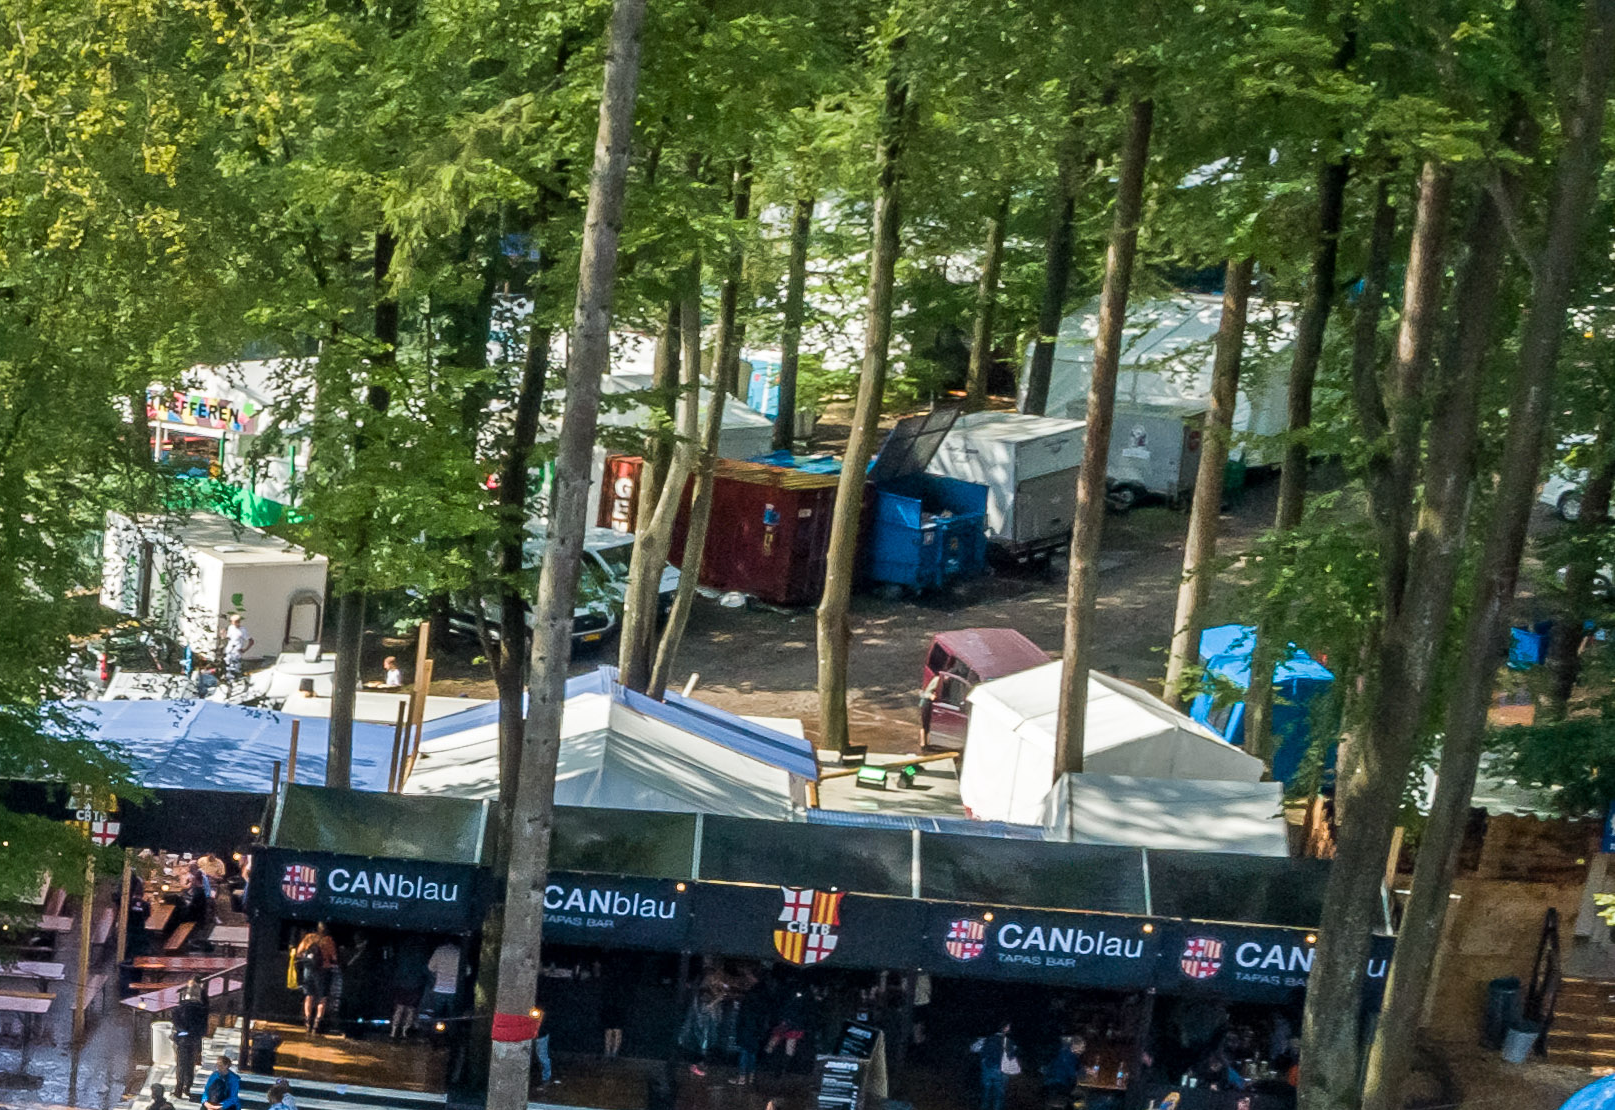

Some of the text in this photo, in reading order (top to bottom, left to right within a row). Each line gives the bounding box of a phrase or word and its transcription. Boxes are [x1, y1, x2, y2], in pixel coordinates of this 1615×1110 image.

[328, 868, 458, 902] CANblau
[329, 895, 399, 910] TAPAS BAR
[543, 885, 676, 919] CANblau
[586, 918, 614, 928] BAR
[998, 923, 1144, 958] CANblau
[998, 953, 1076, 968] TAPAS BAR
[1235, 942, 1387, 977] CANu
[1236, 972, 1307, 987] TAPAS BA
